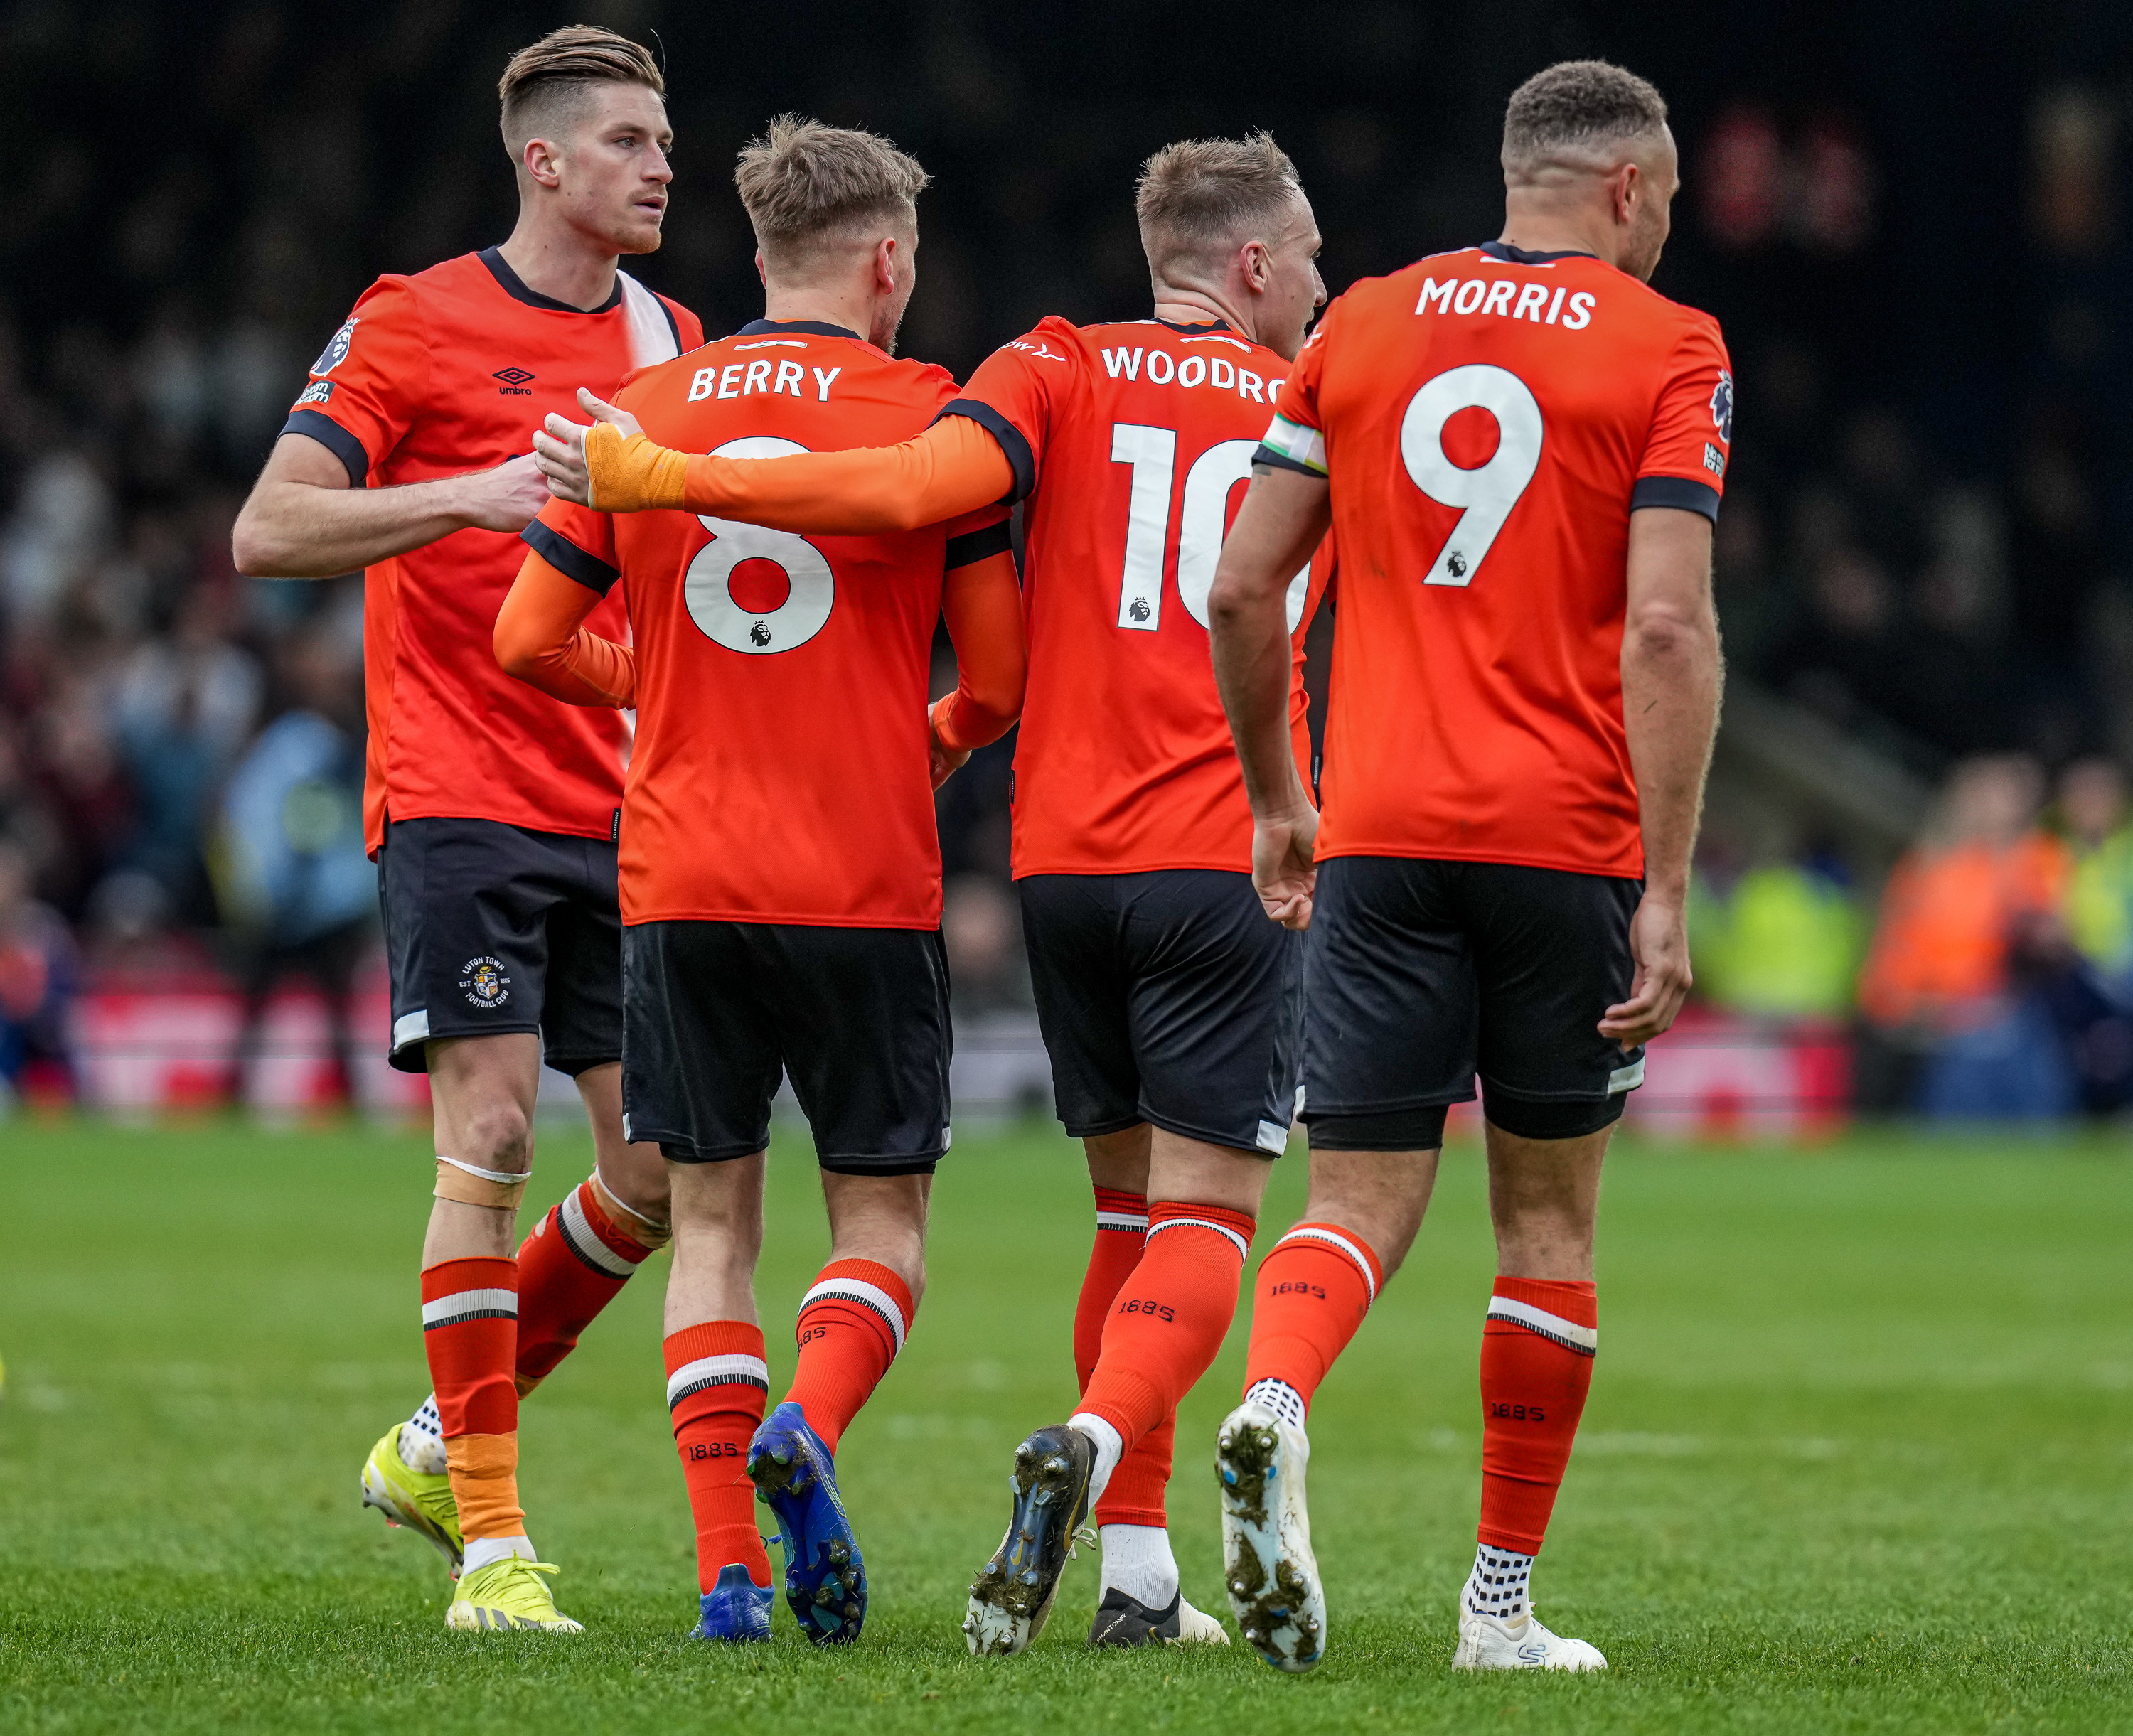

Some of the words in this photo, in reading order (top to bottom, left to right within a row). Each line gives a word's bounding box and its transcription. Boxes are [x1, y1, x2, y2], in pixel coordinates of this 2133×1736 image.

[1414, 277, 1596, 330] MORRIS
[499, 385, 532, 395] umbro
[687, 359, 843, 402] BERRY
[1400, 363, 1544, 588] 9
[1110, 422, 1311, 636] 10
[684, 436, 835, 655] 8
[462, 956, 483, 975] LUTON
[485, 956, 505, 971] TOWN
[465, 992, 497, 1008] FOOTBALL
[495, 989, 509, 1004] CLUB
[1271, 1281, 1325, 1300] 1885
[1118, 1299, 1176, 1322] 1885
[1492, 1403, 1544, 1421] 1885
[688, 1442, 738, 1461] 1885
